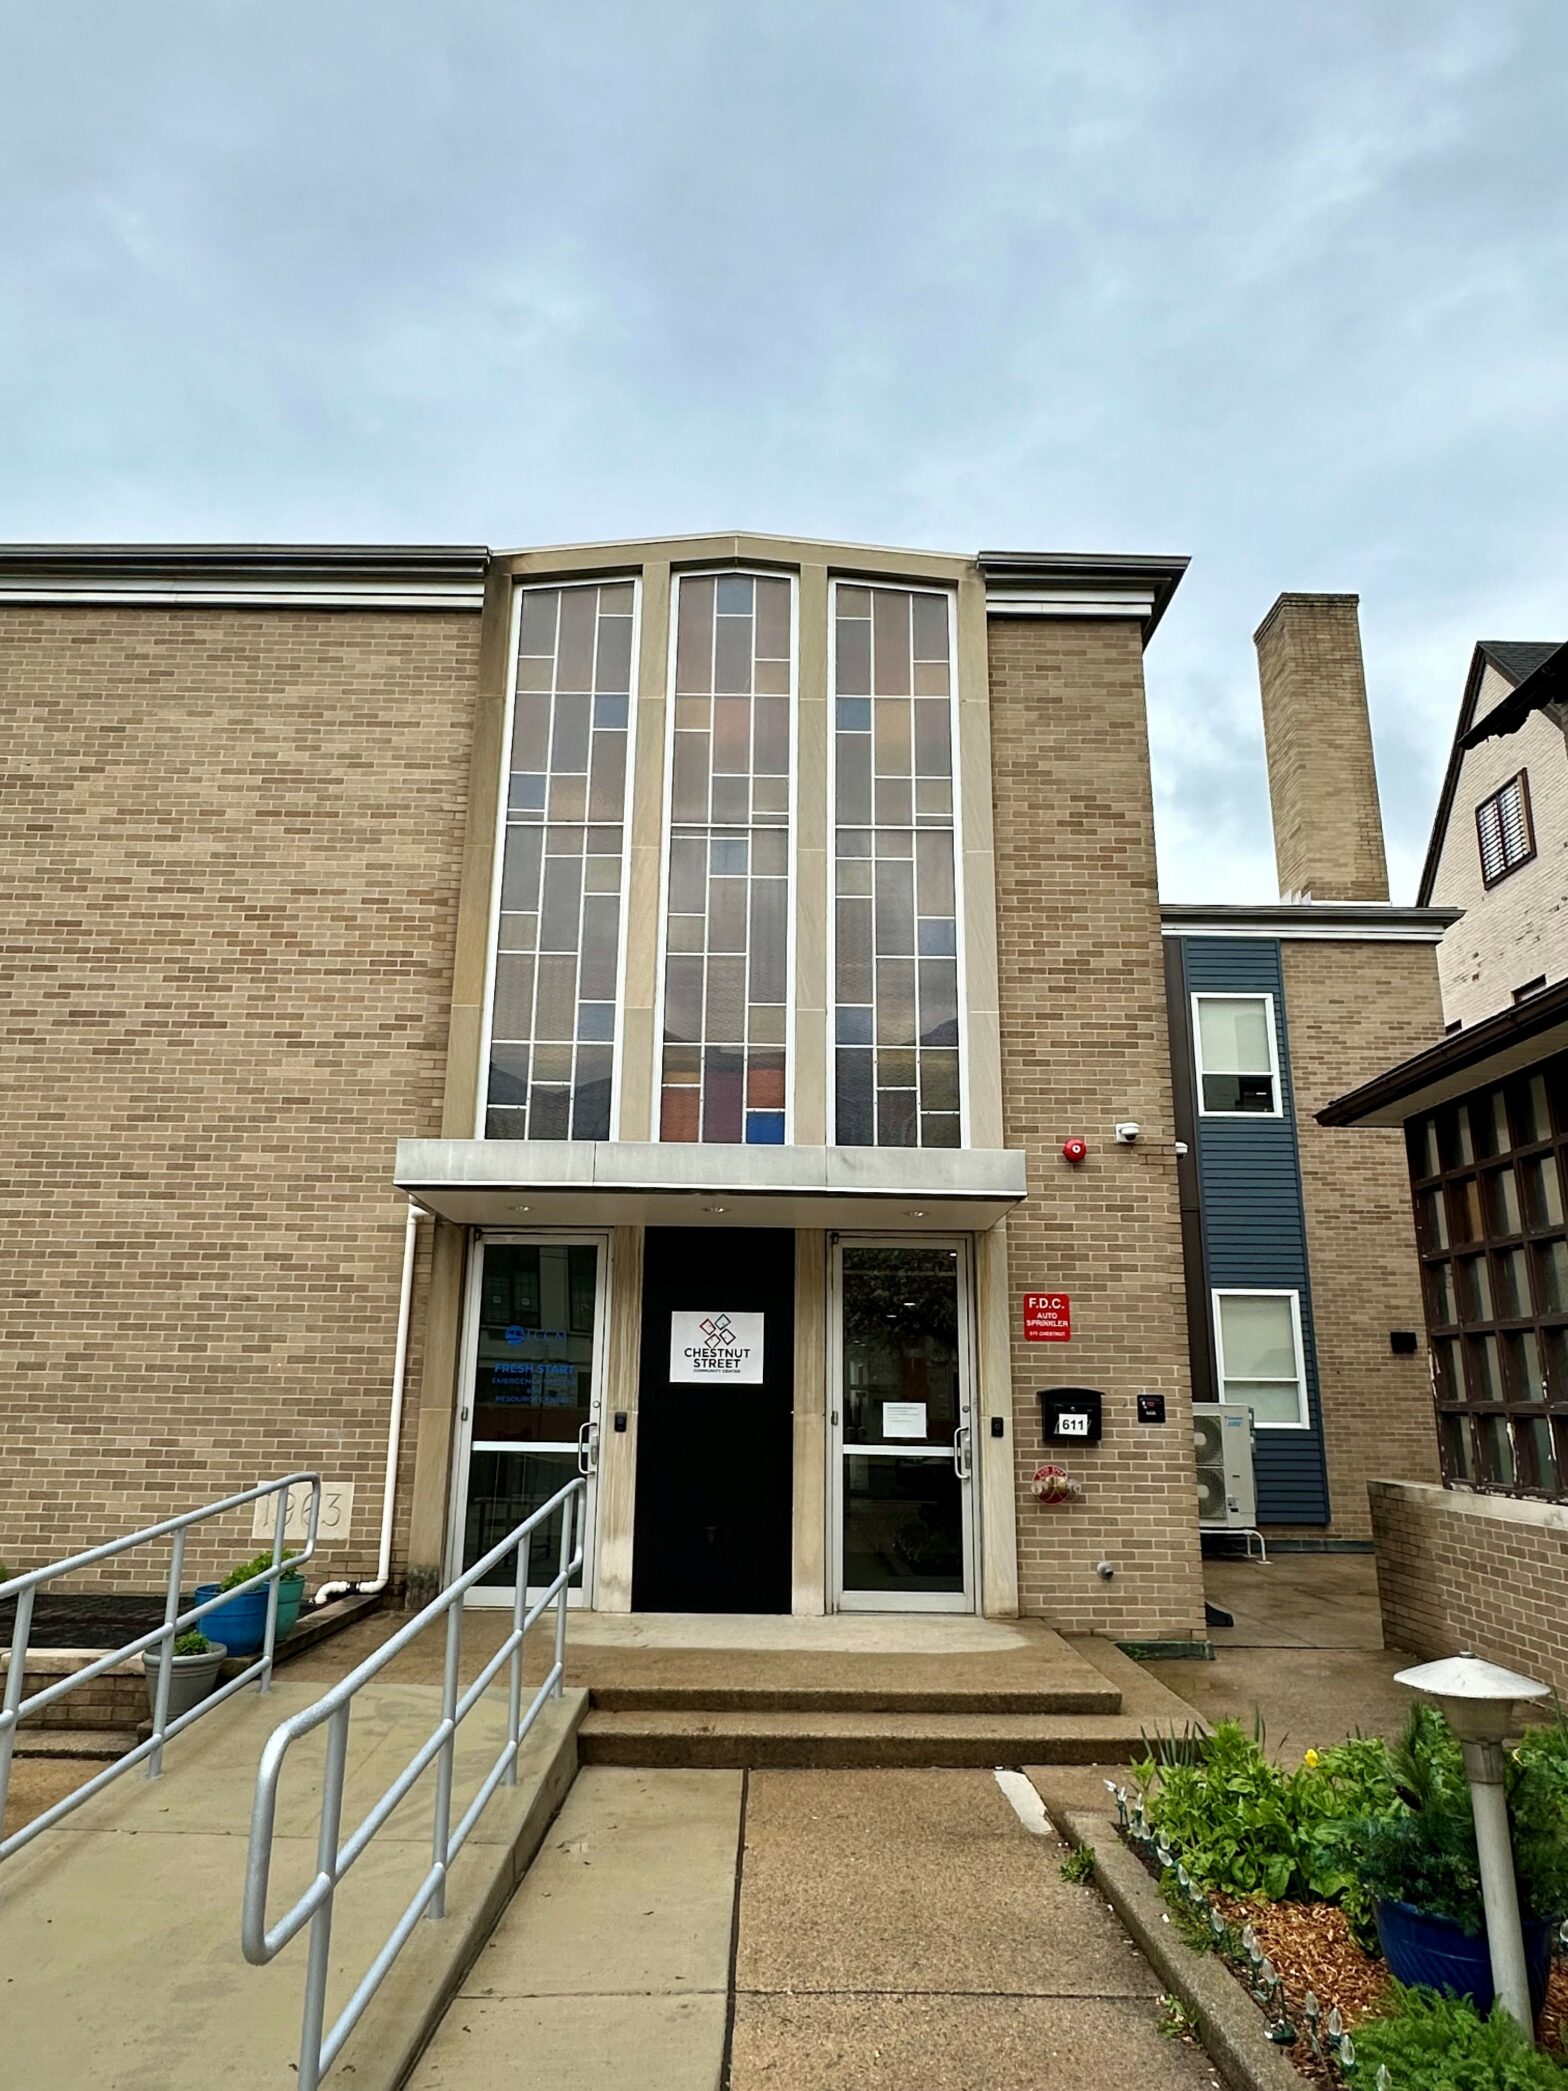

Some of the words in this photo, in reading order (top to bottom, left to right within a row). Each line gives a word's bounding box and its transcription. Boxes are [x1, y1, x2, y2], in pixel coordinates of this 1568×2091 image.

[1028, 1297, 1065, 1309] F.D.C.
[684, 1347, 751, 1358] CHESTNUT
[693, 1358, 741, 1368] STREET
[494, 1363, 533, 1373] FRESH
[537, 1364, 575, 1375] START
[1062, 1419, 1085, 1430] 611
